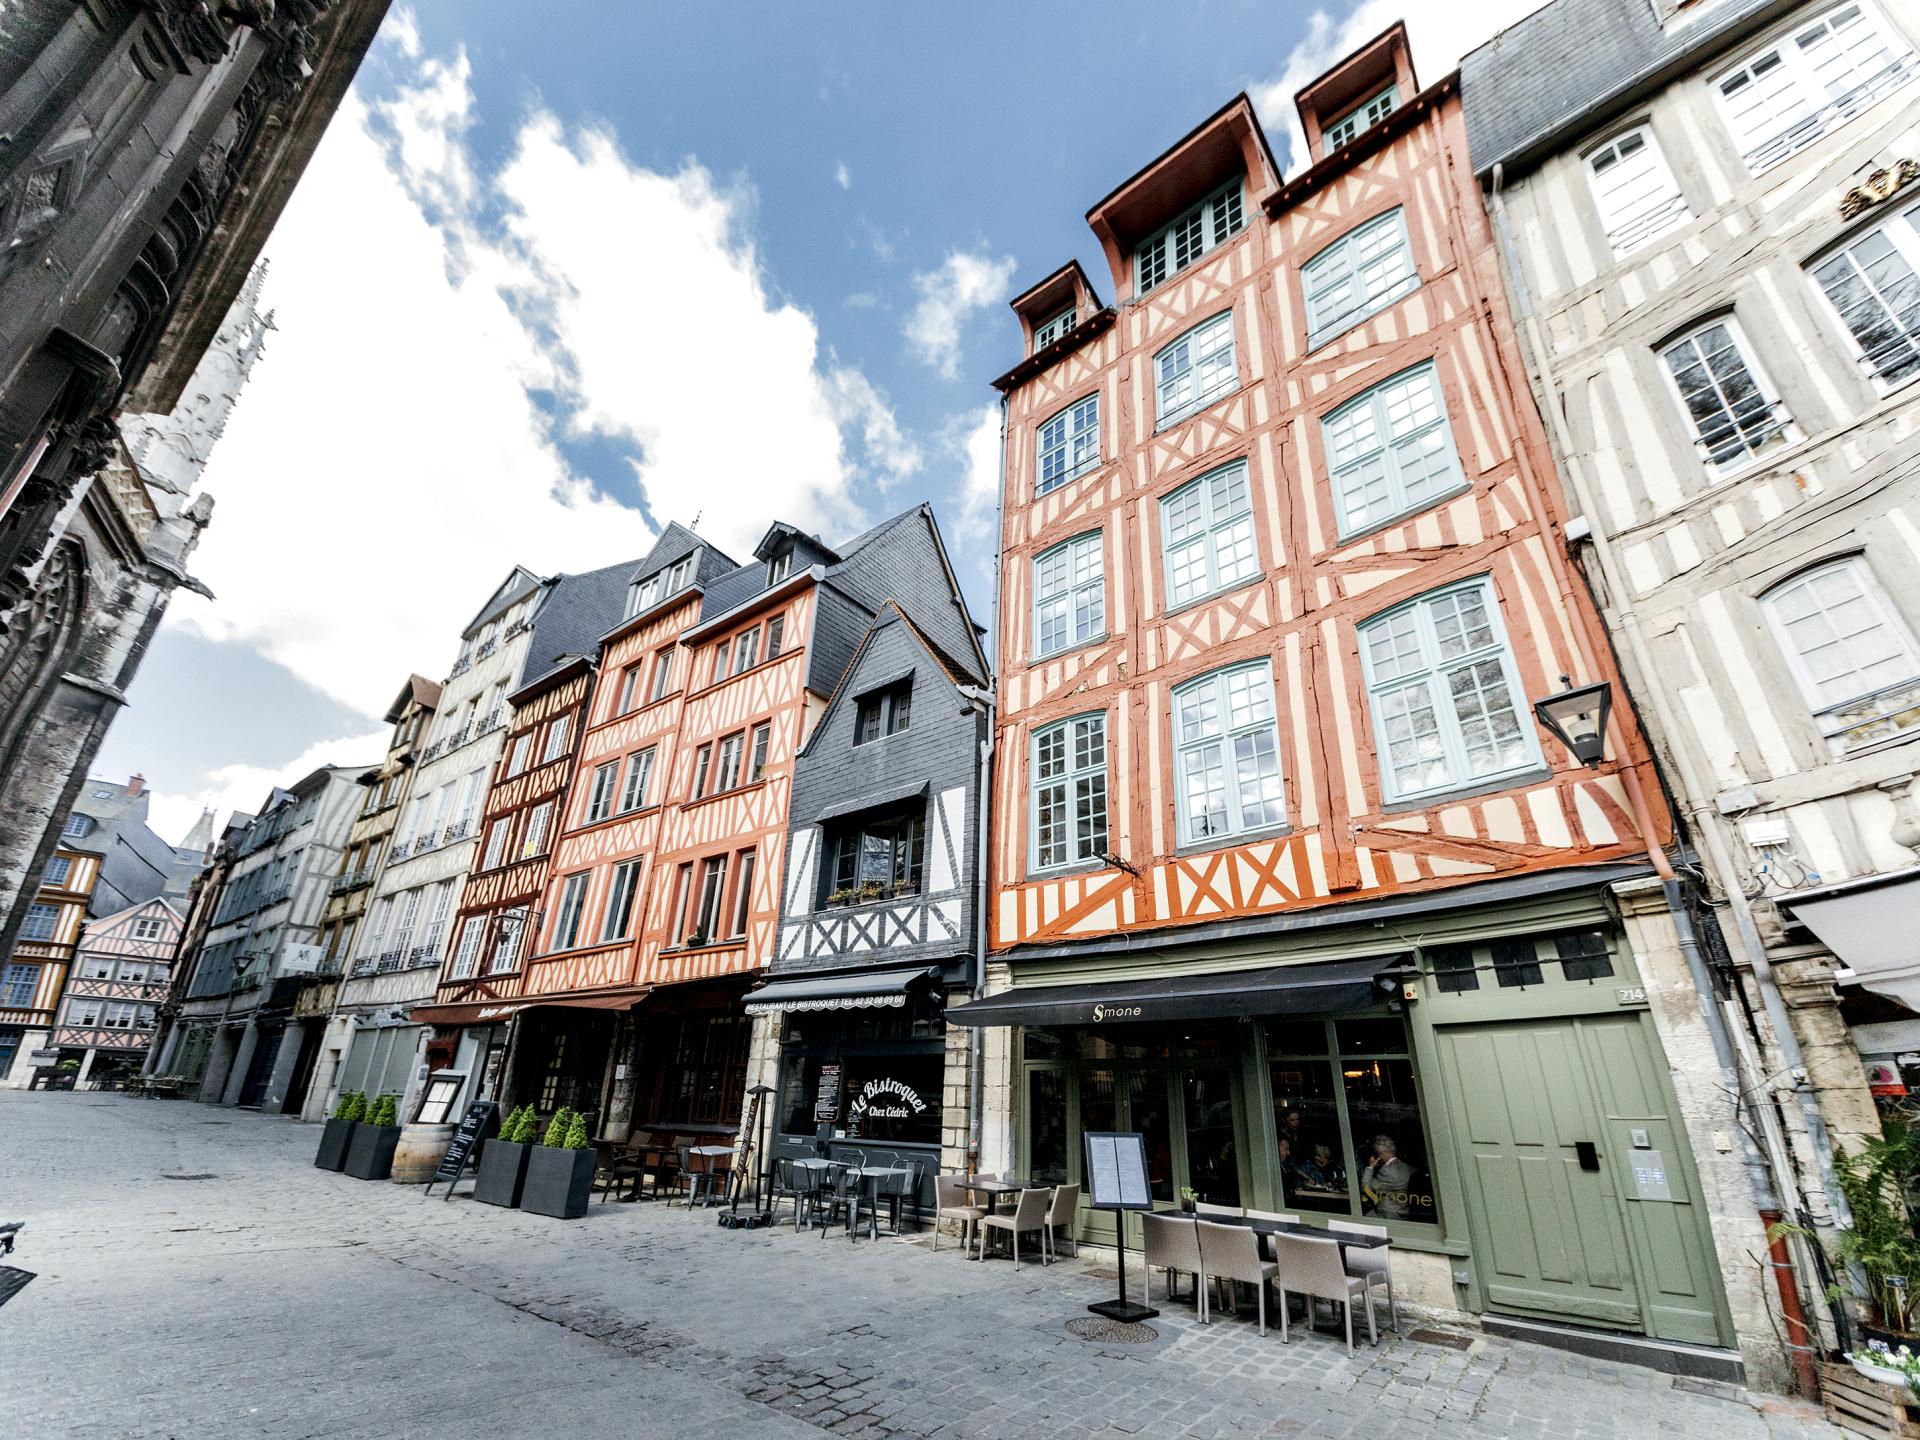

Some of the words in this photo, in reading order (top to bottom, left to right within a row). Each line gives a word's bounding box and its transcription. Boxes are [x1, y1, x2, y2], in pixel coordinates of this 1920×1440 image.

[1618, 988, 1646, 1001] 214
[745, 1002, 786, 1011] RESTAURANT
[787, 1001, 797, 1009] LE
[797, 999, 840, 1009] BISTROQUET
[851, 1094, 868, 1114] Le
[863, 1077, 928, 1114] Bistroquet
[869, 1106, 885, 1117] Chez
[886, 1106, 909, 1118] Cédric
